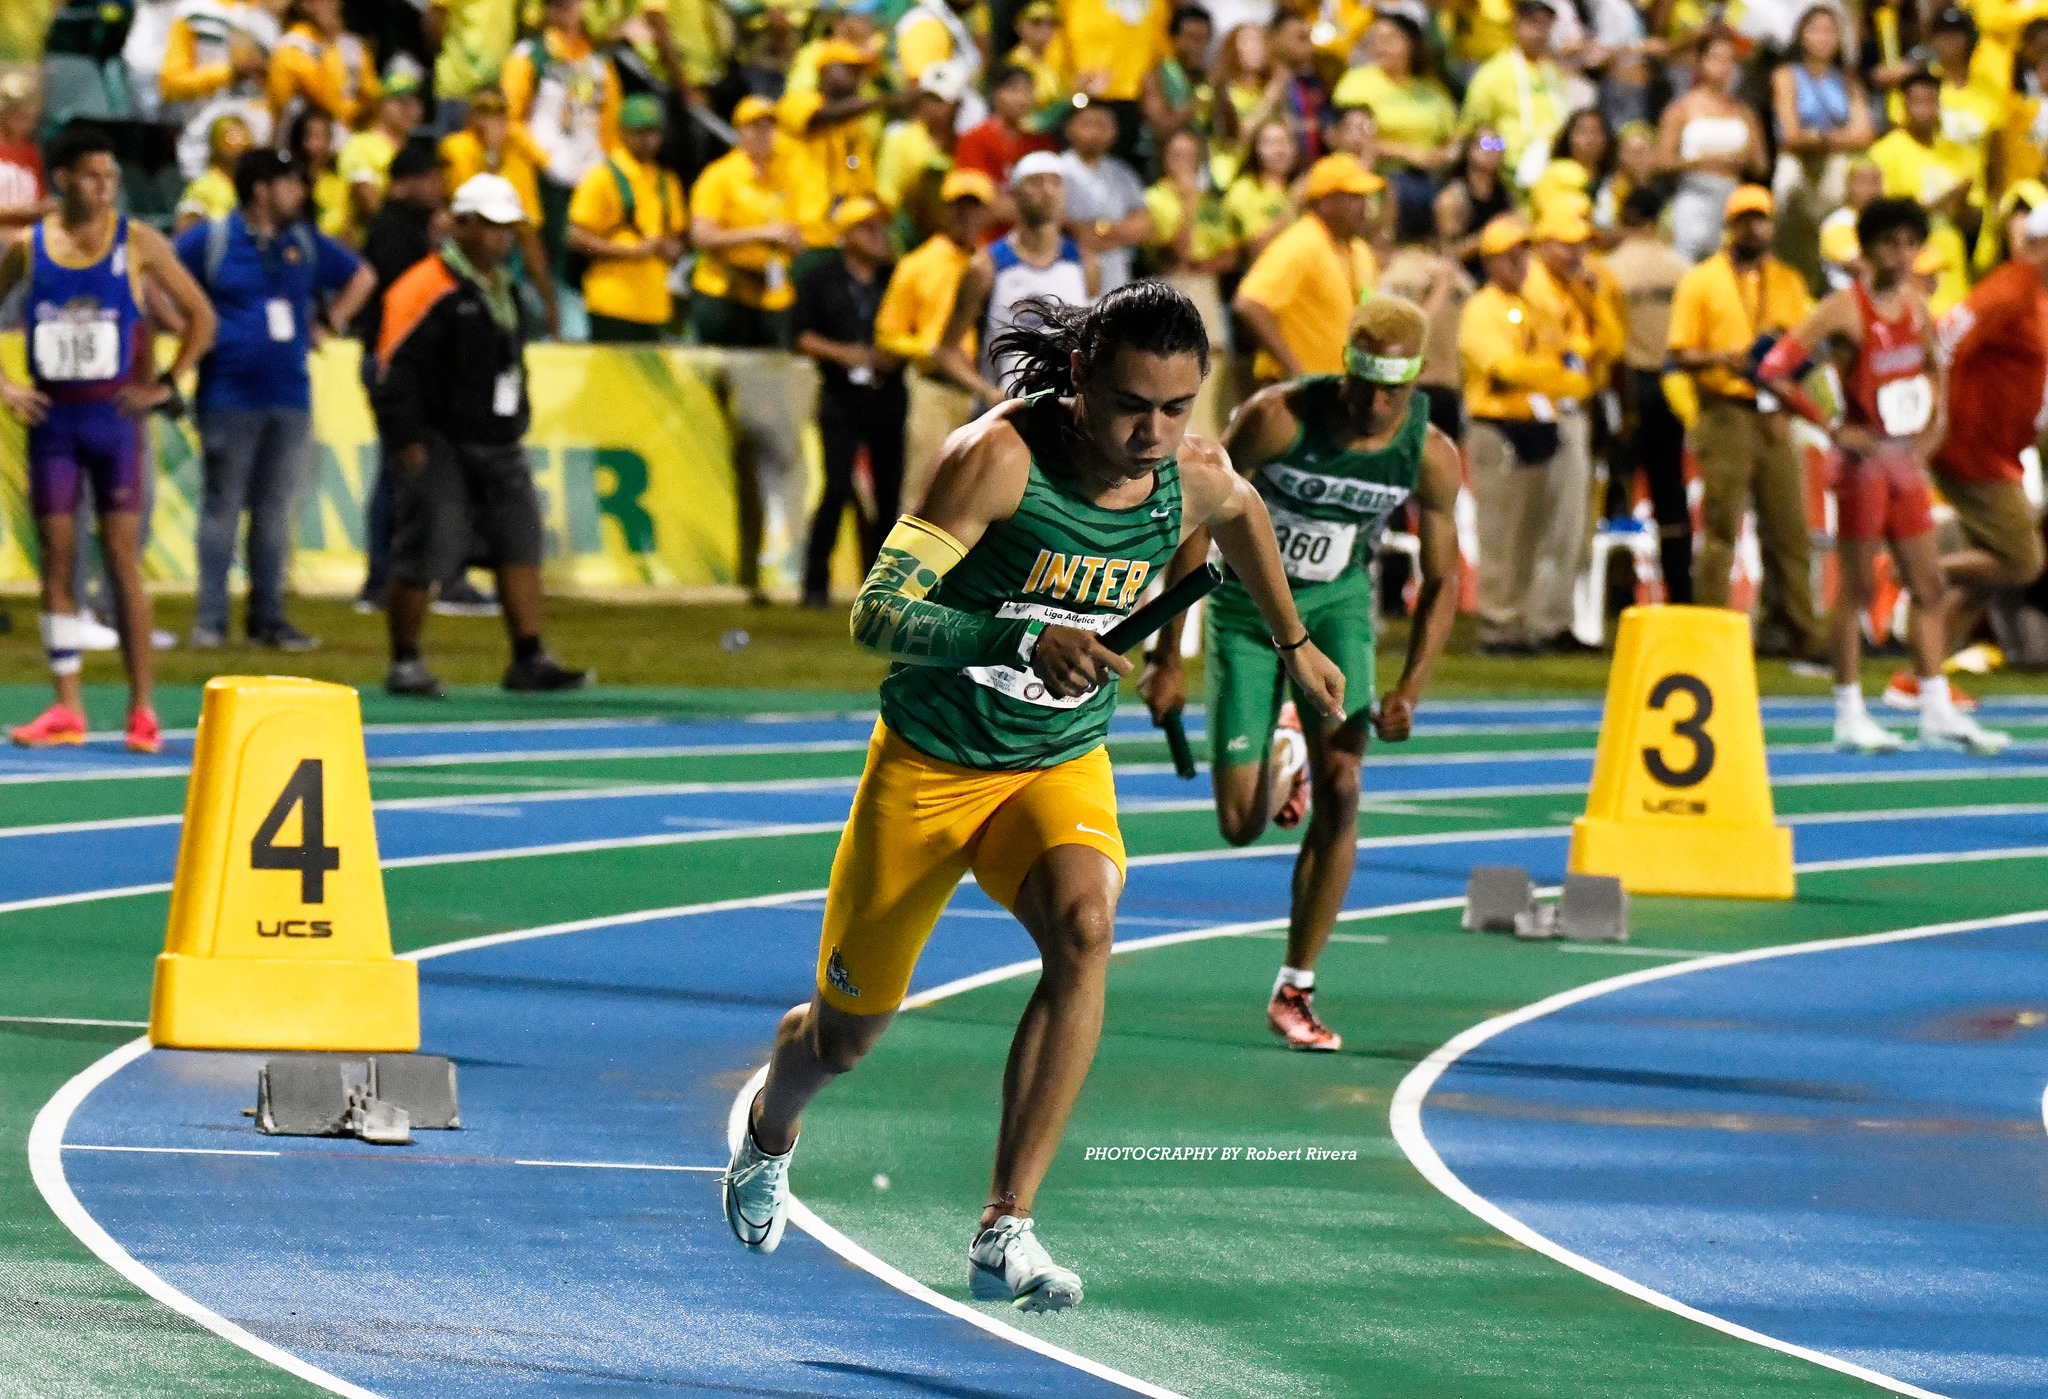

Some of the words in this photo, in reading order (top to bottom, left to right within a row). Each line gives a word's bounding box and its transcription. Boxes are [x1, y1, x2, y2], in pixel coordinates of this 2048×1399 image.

[1276, 525, 1331, 564] 360
[1021, 549, 1150, 609] INTER
[1043, 608, 1063, 621] Liga
[1642, 673, 1716, 788] 3
[1641, 798, 1706, 816] UCS
[250, 759, 340, 904] 4
[257, 920, 333, 938] UCS
